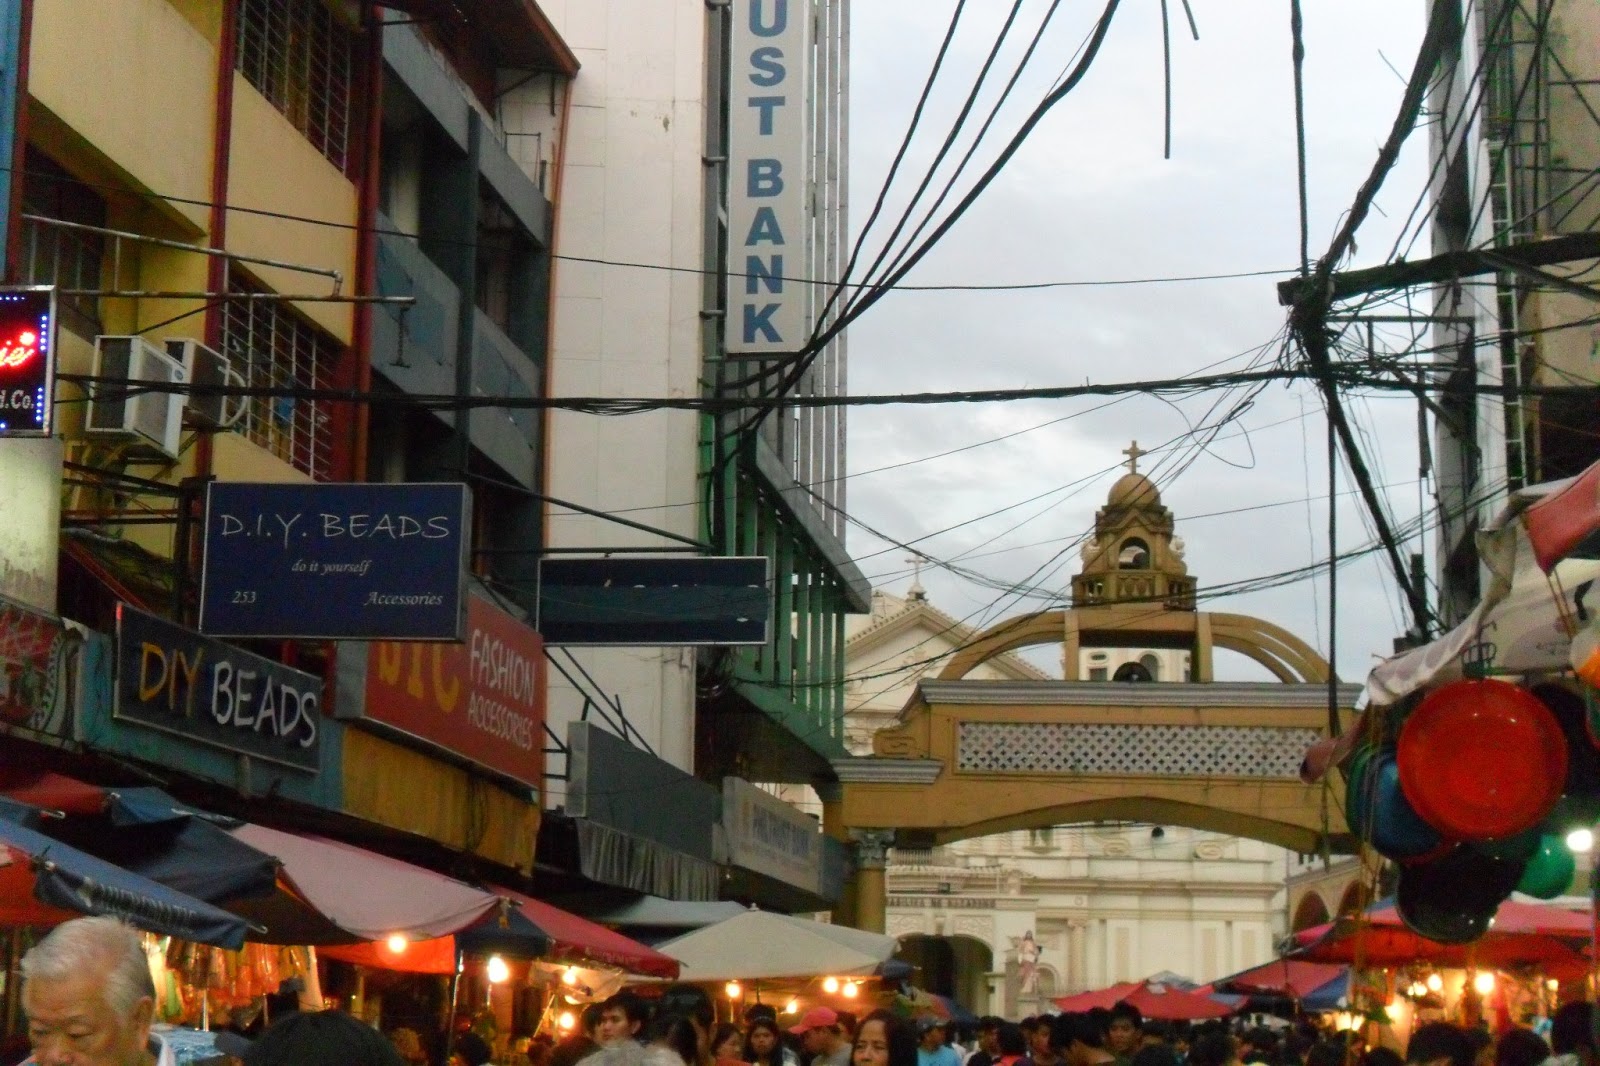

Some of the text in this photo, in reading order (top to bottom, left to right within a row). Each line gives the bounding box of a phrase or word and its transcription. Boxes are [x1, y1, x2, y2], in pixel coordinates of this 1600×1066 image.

[743, 158, 786, 344] BANK
[221, 513, 449, 549] D.I.Y. BEADS
[291, 559, 373, 576] do it yourself
[232, 591, 257, 604] 253
[363, 591, 443, 606] Accessories
[469, 628, 535, 707] FASHION
[139, 641, 204, 719] DIY
[211, 661, 318, 748] BEADS
[467, 691, 533, 751] ACCESSORIES
